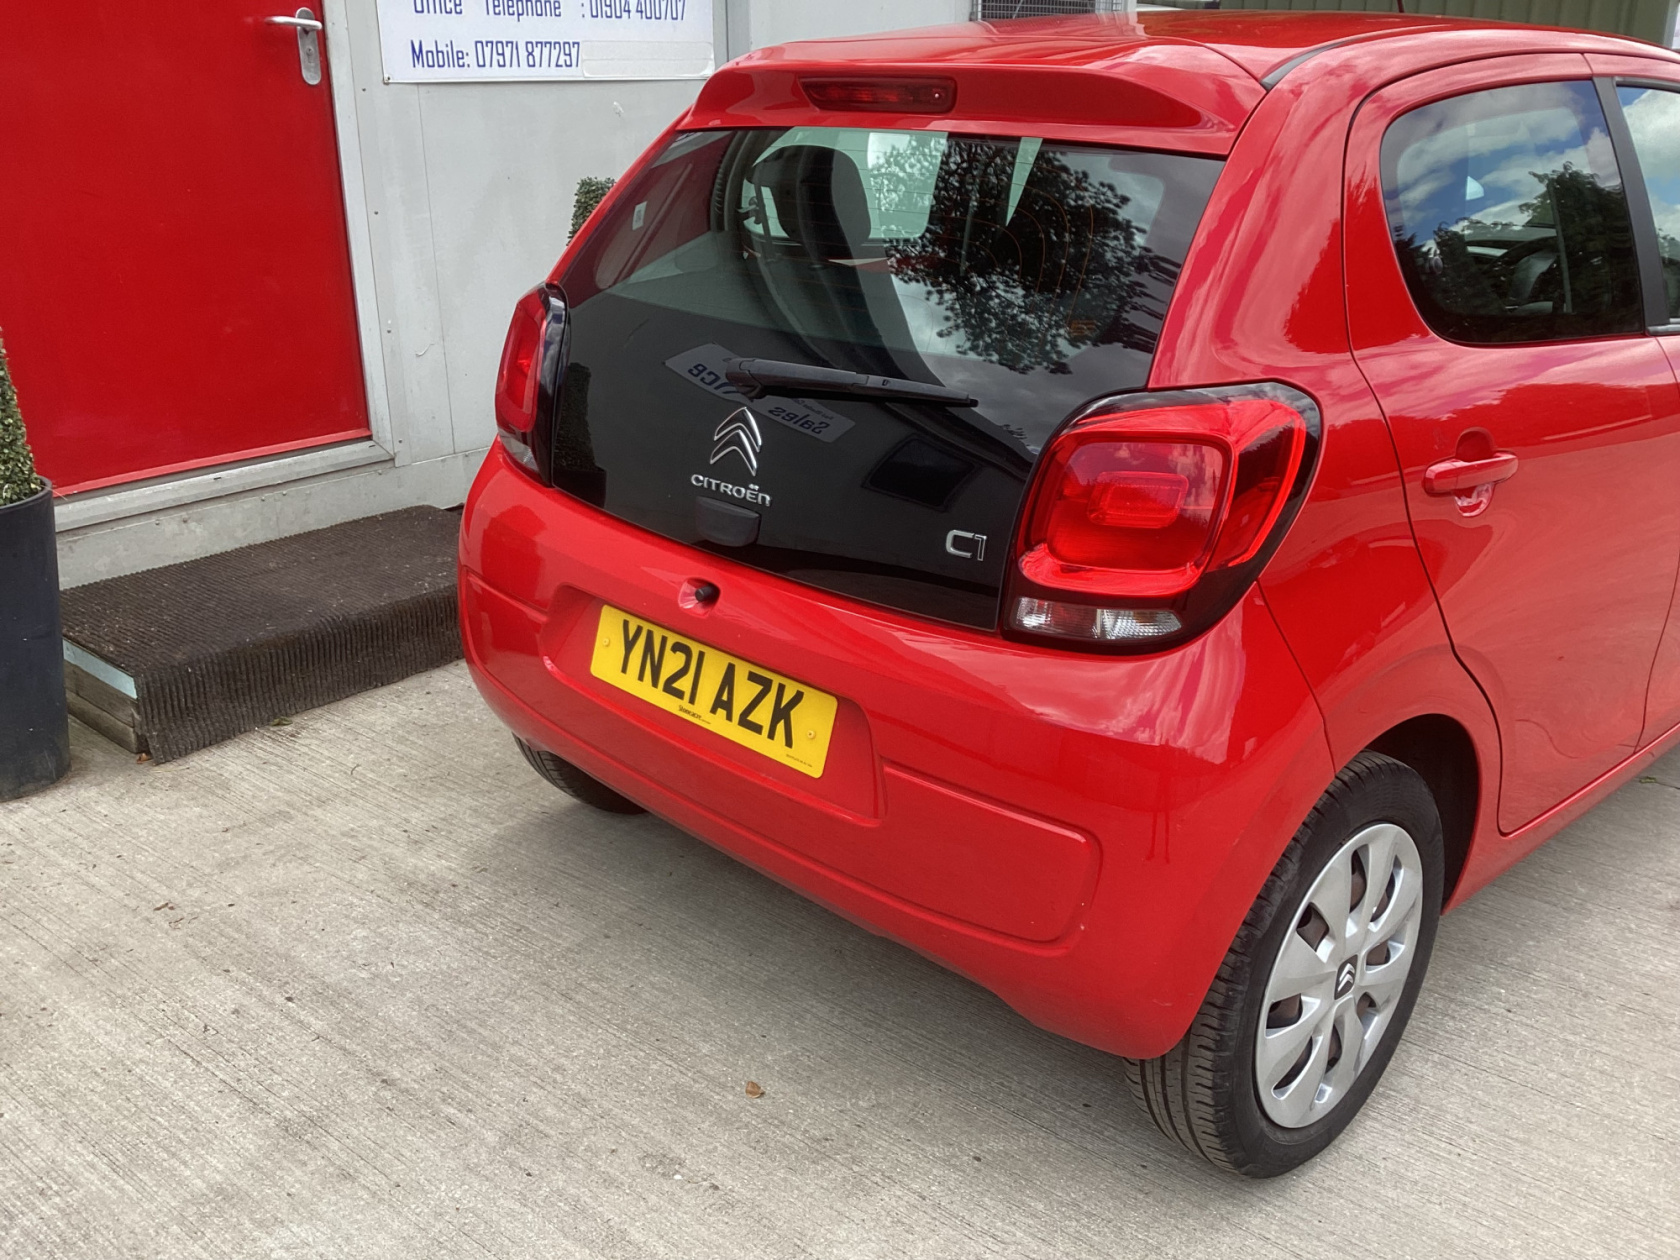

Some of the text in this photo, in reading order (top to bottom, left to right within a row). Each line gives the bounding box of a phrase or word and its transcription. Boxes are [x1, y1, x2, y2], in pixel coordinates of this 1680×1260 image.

[485, 0, 561, 22] Telephone
[635, 0, 686, 21] 400707
[410, 39, 580, 68] Mobile: 07971 877297
[690, 474, 772, 507] CITROËN
[945, 529, 987, 561] C1
[620, 618, 805, 750] YN21 AZK
